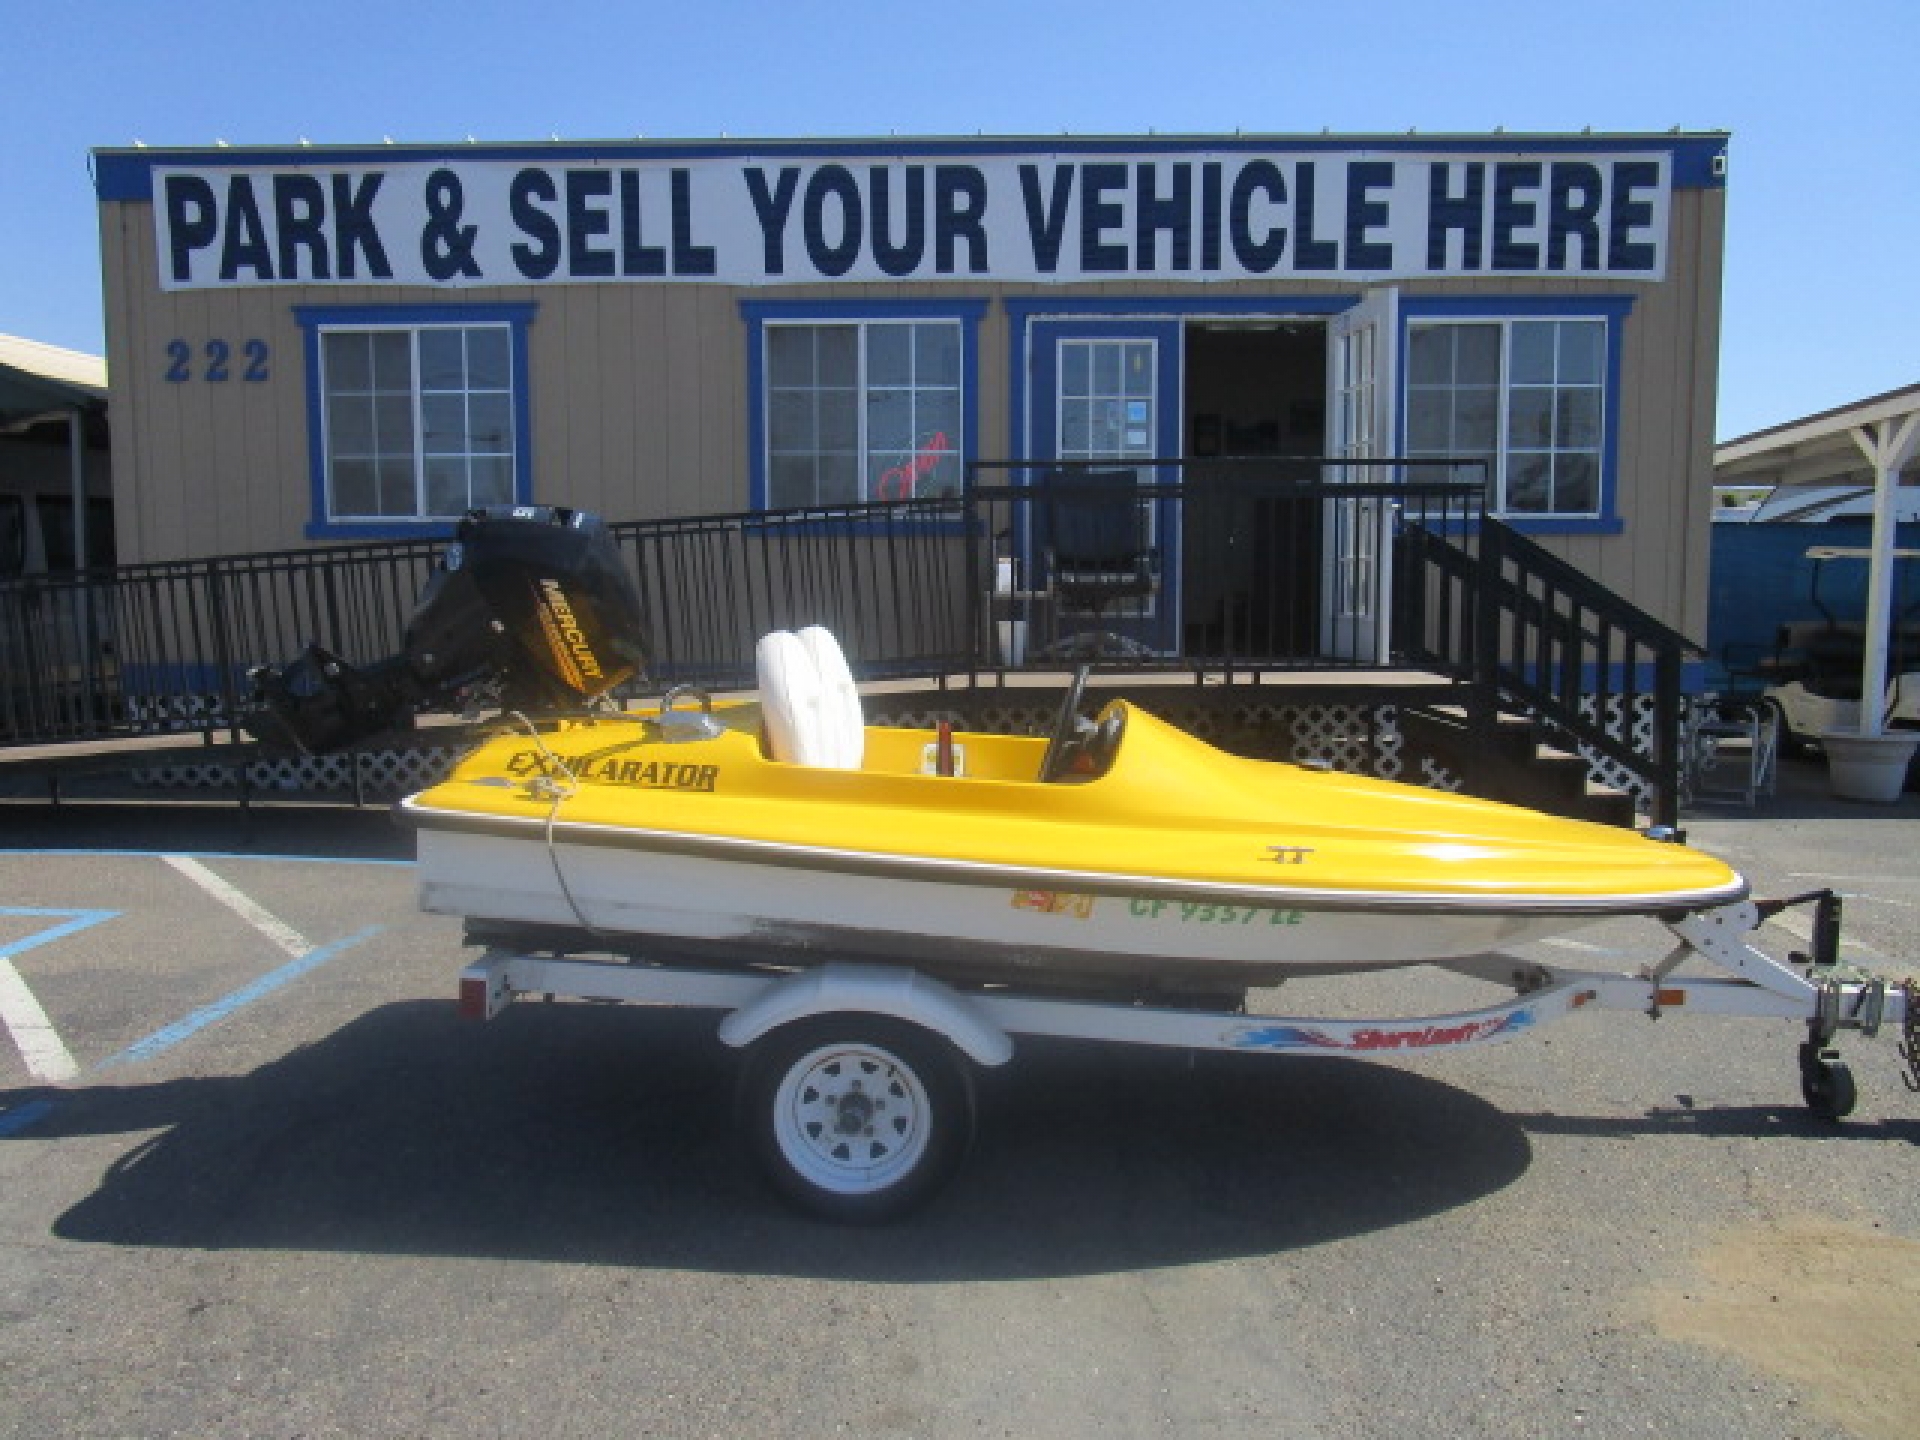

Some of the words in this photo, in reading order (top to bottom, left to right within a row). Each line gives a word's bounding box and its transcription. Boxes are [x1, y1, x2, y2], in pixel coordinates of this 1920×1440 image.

[164, 170, 395, 283] PARK
[419, 166, 485, 283] &
[508, 166, 717, 280] SELL
[742, 163, 989, 278] YOUR
[1018, 160, 1396, 275] VEHICLE
[1426, 160, 1660, 272] HERE
[165, 339, 271, 383] 222
[539, 578, 604, 679] MERCURY
